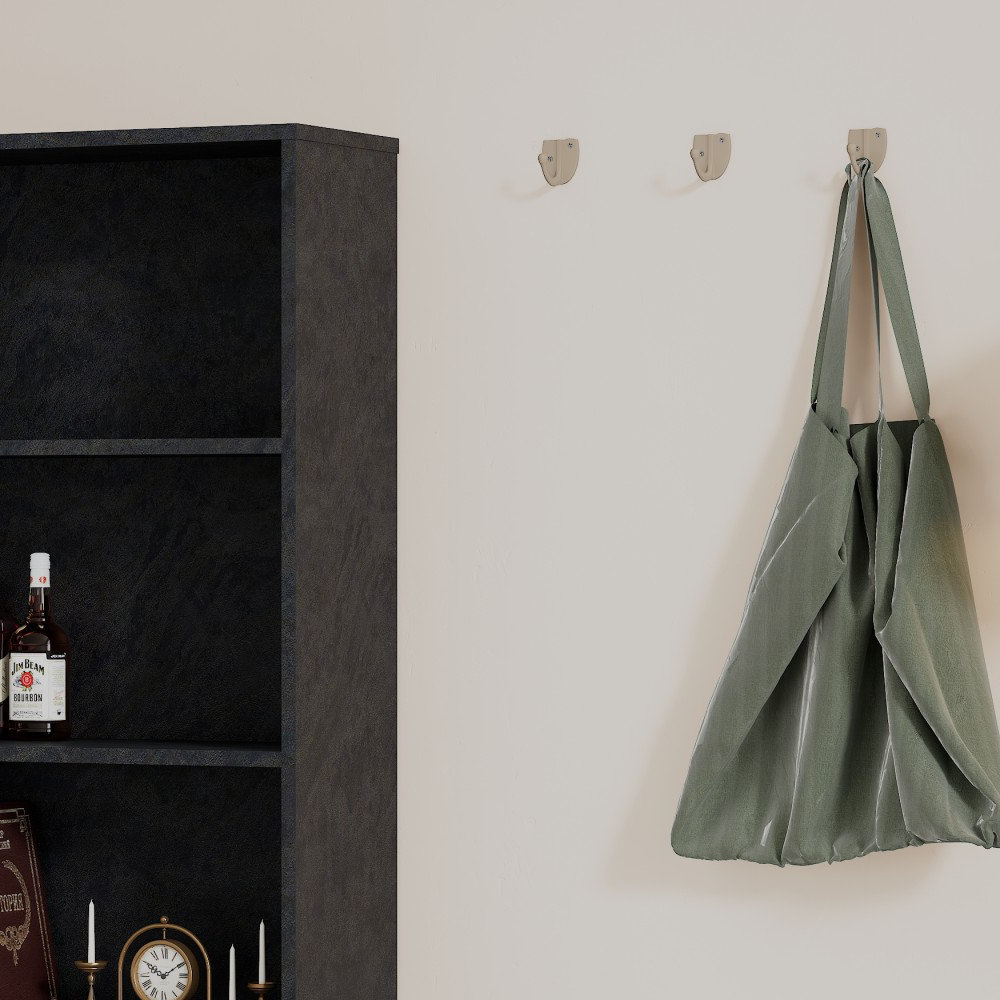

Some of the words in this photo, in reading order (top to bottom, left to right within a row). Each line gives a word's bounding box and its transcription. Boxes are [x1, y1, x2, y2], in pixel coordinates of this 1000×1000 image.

[12, 662, 24, 675] JIM
[25, 658, 45, 675] BEAM
[14, 693, 43, 702] BOURBON
